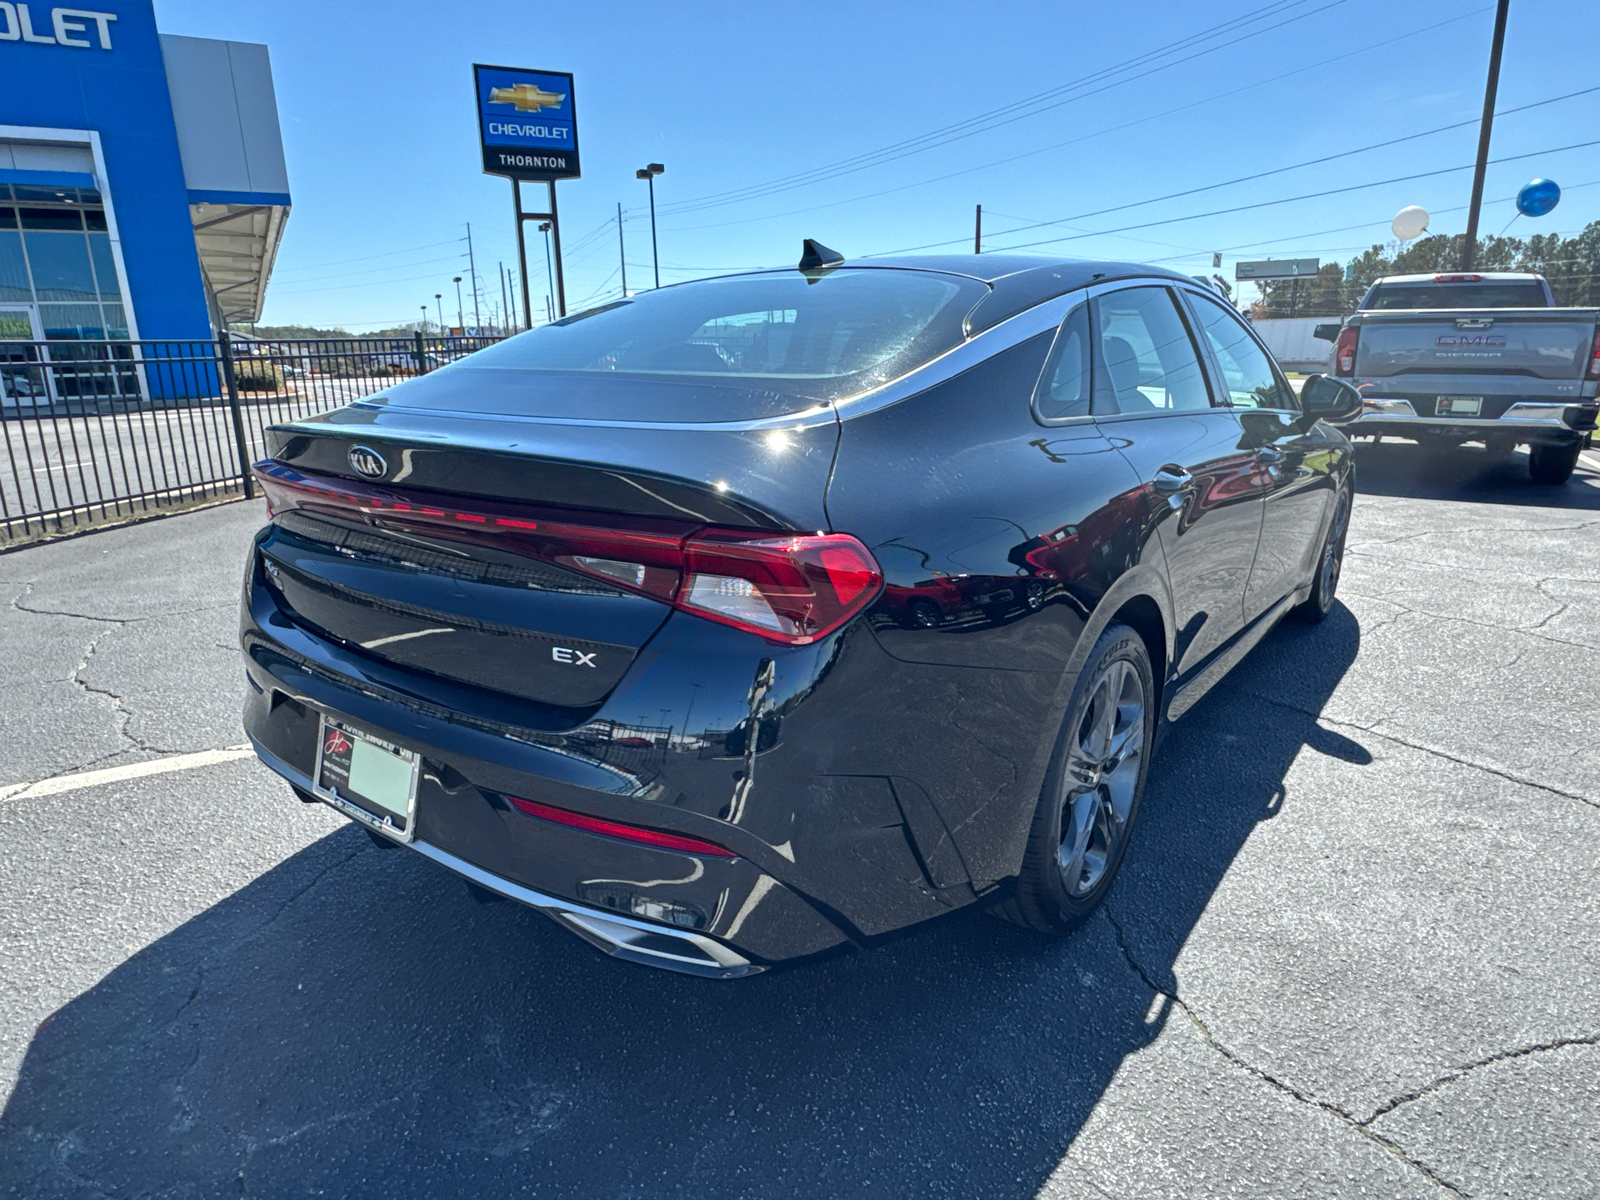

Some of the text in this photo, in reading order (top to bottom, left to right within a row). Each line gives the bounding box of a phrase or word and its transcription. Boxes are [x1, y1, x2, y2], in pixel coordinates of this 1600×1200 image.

[489, 123, 568, 139] CHEVROLET
[499, 154, 566, 168] THORNTON
[1435, 335, 1506, 347] GMC
[350, 452, 382, 475] KIA
[552, 646, 597, 668] EX
